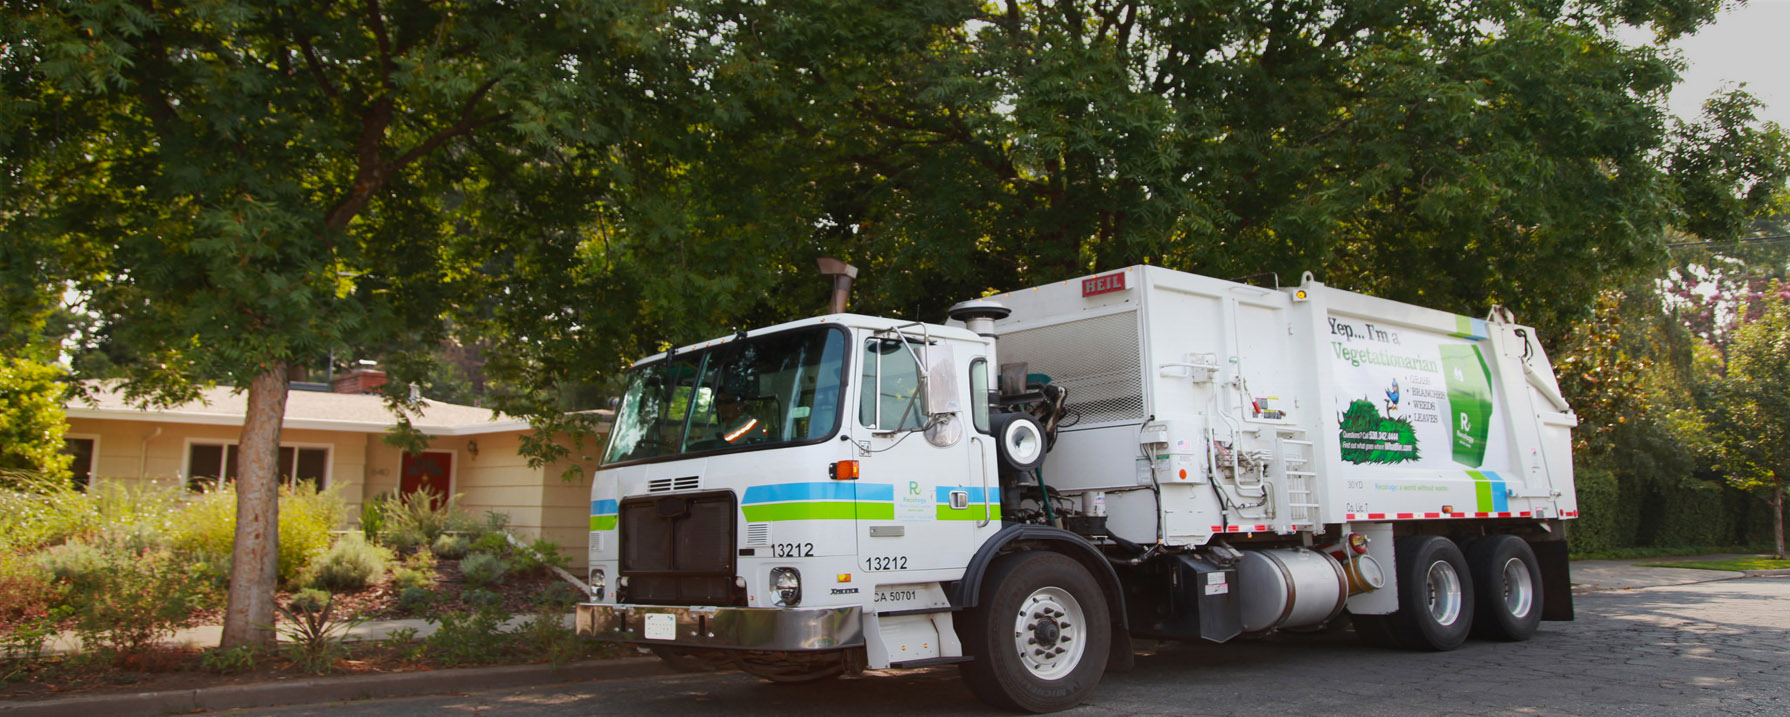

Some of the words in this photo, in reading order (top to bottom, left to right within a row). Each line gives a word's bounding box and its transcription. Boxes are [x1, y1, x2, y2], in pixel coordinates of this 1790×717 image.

[1085, 275, 1121, 293] HEIL
[1328, 317, 1365, 342] Yep...
[1365, 323, 1390, 343] I'm
[1391, 332, 1400, 345] a
[1331, 341, 1439, 373] Vegetationarian
[1411, 387, 1446, 400] BRANCHES
[1413, 400, 1436, 411] WEEDS
[1414, 412, 1439, 423] LEAVES
[770, 542, 814, 558] 13212
[866, 556, 908, 571] 13212
[890, 591, 917, 602] 50701
